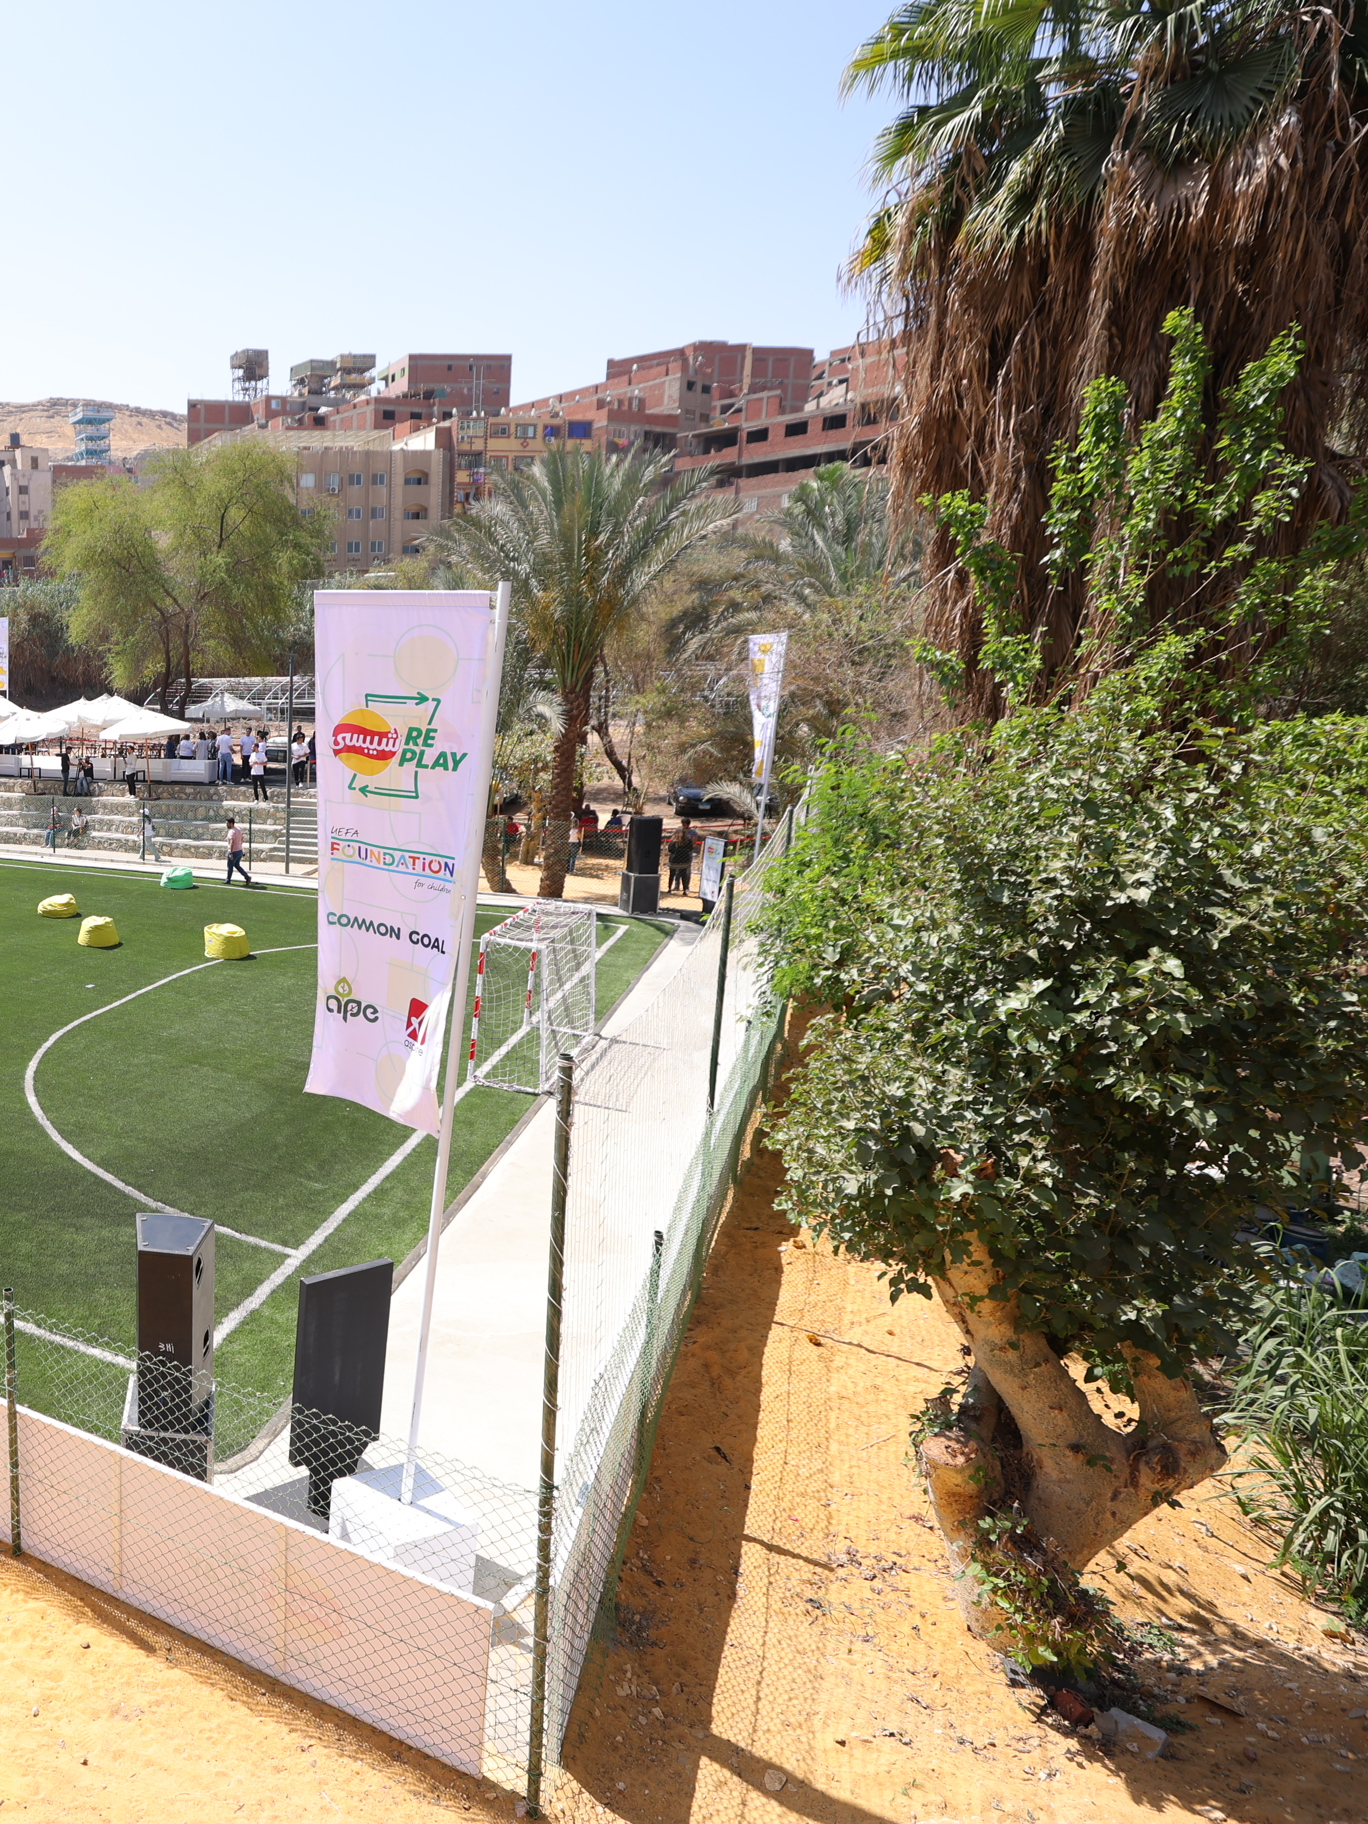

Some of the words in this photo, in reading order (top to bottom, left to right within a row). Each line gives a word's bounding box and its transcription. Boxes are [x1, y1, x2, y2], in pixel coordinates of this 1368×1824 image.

[404, 727, 438, 748] RE
[398, 748, 468, 772] PLAY
[330, 826, 360, 837] UEFA
[330, 841, 456, 878] FOUNDATION
[414, 879, 425, 890] for
[427, 881, 452, 895] children
[326, 911, 401, 940] COMMON
[408, 930, 446, 955] GOAL
[325, 994, 380, 1023] ape
